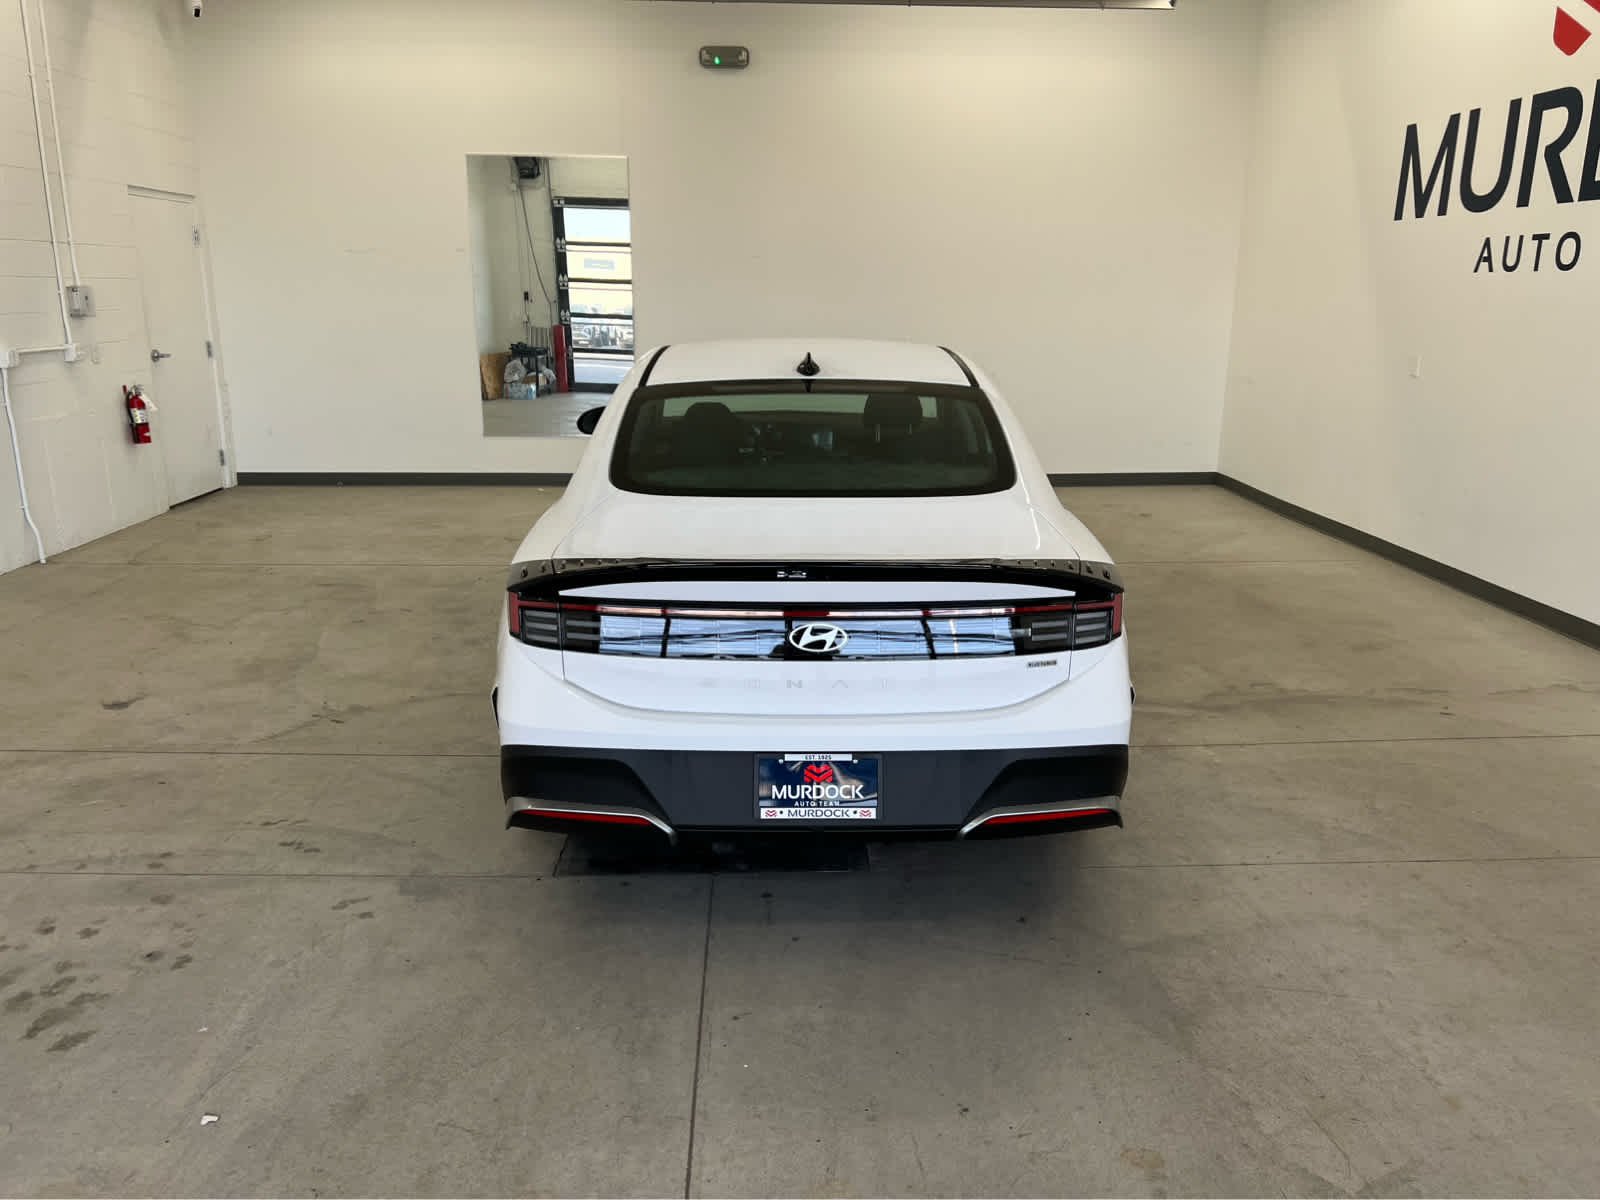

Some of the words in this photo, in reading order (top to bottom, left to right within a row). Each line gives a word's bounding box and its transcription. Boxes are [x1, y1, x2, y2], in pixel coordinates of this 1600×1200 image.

[1394, 79, 1600, 221] MUR
[1473, 231, 1582, 273] AUTO
[771, 784, 864, 799] MURDOCK
[787, 809, 851, 818] MURDOCK
